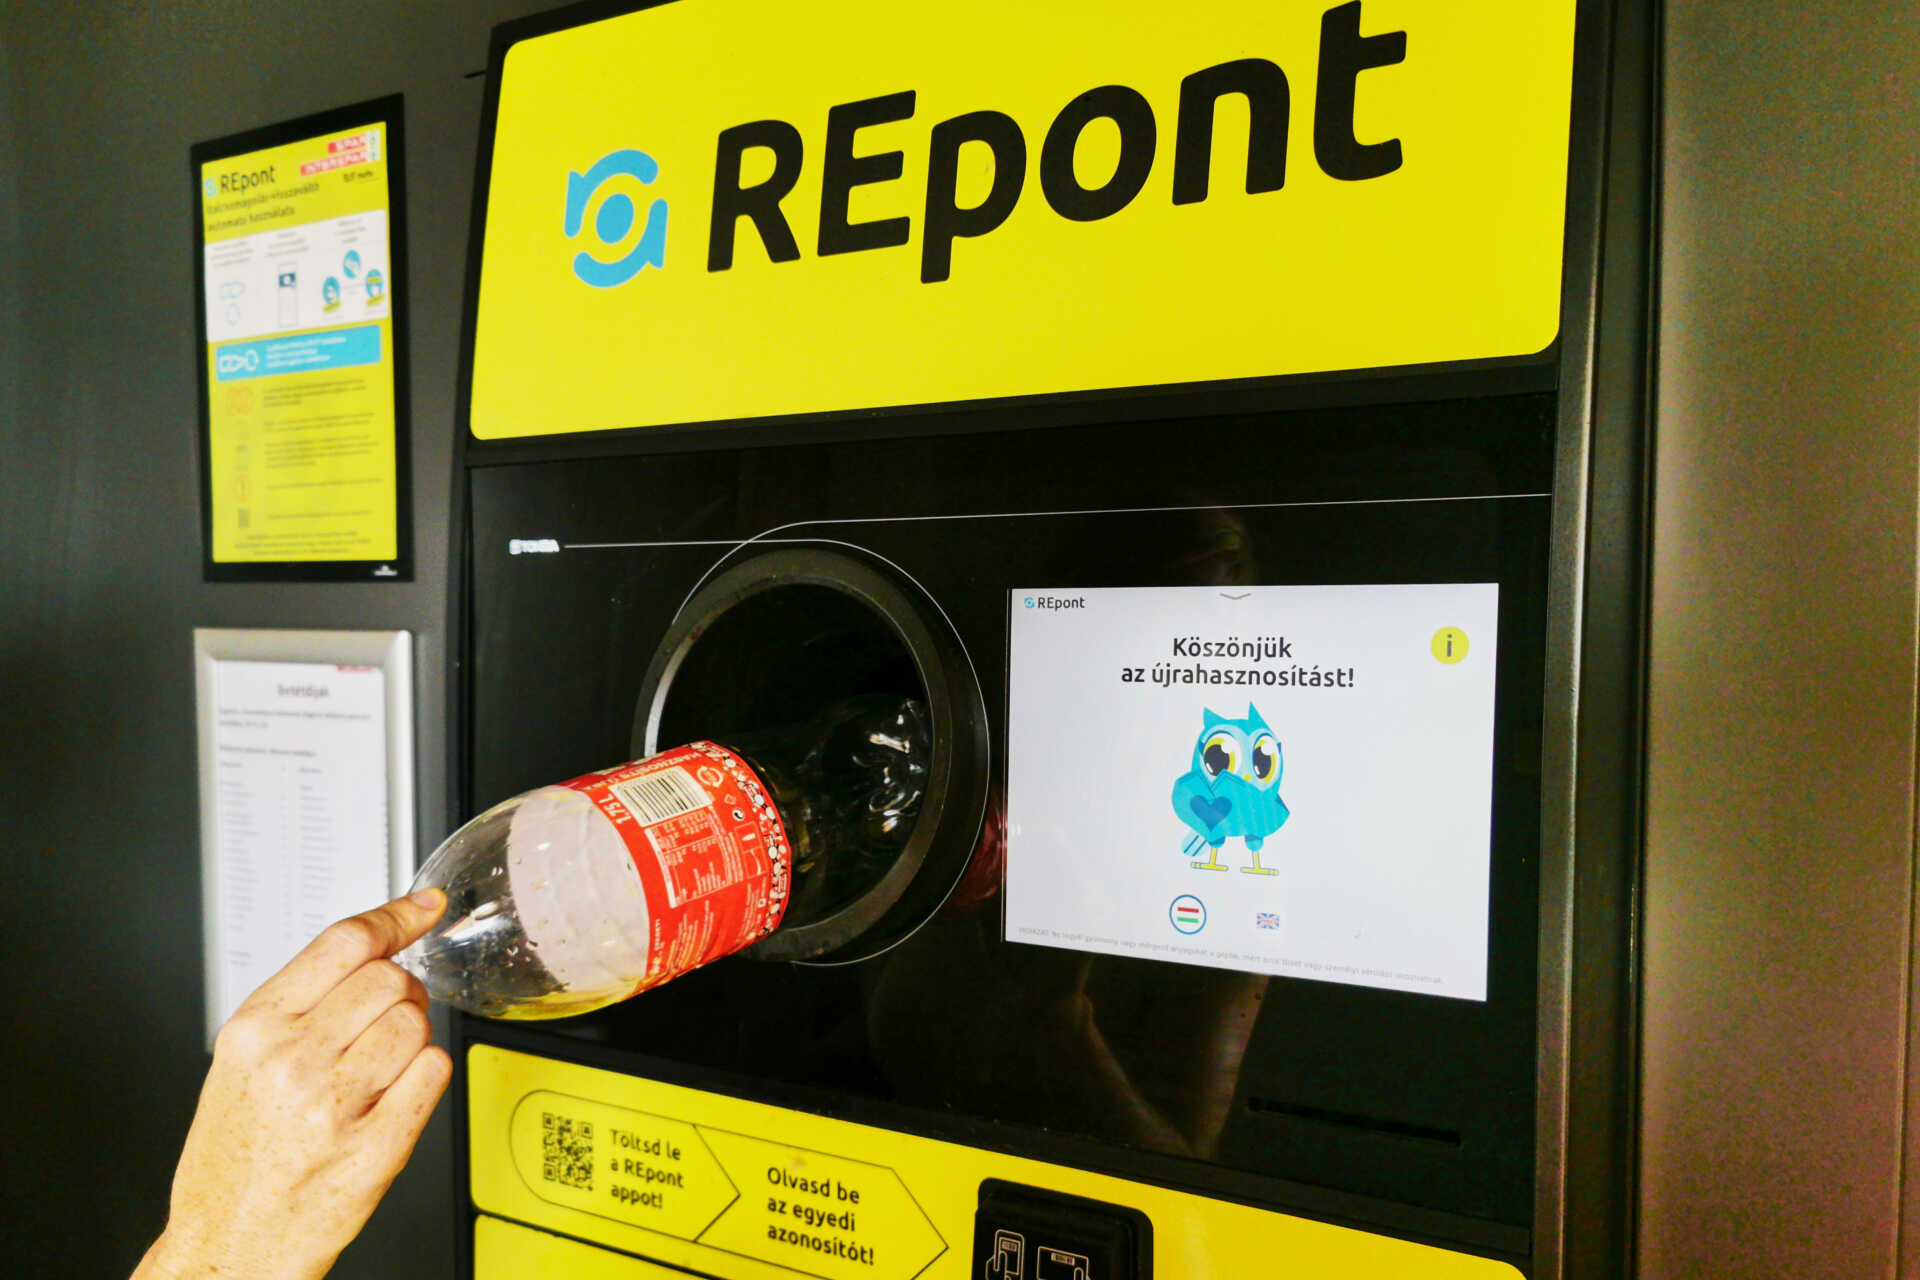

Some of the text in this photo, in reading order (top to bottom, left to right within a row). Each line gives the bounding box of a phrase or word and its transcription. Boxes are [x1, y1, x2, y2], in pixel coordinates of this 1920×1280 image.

[707, 0, 1407, 284] REpont
[220, 165, 276, 196] REpont
[1037, 596, 1086, 612] REpont
[1173, 636, 1292, 662] Köszönjük
[1121, 662, 1354, 688] az újrahasznosítást!
[667, 1140, 681, 1161] le
[611, 1159, 684, 1189] a REpont
[767, 1166, 860, 1204] Olvasd be
[611, 1184, 663, 1209] appot!
[767, 1198, 855, 1232] az egyedi
[767, 1224, 874, 1267] azonosítót!
